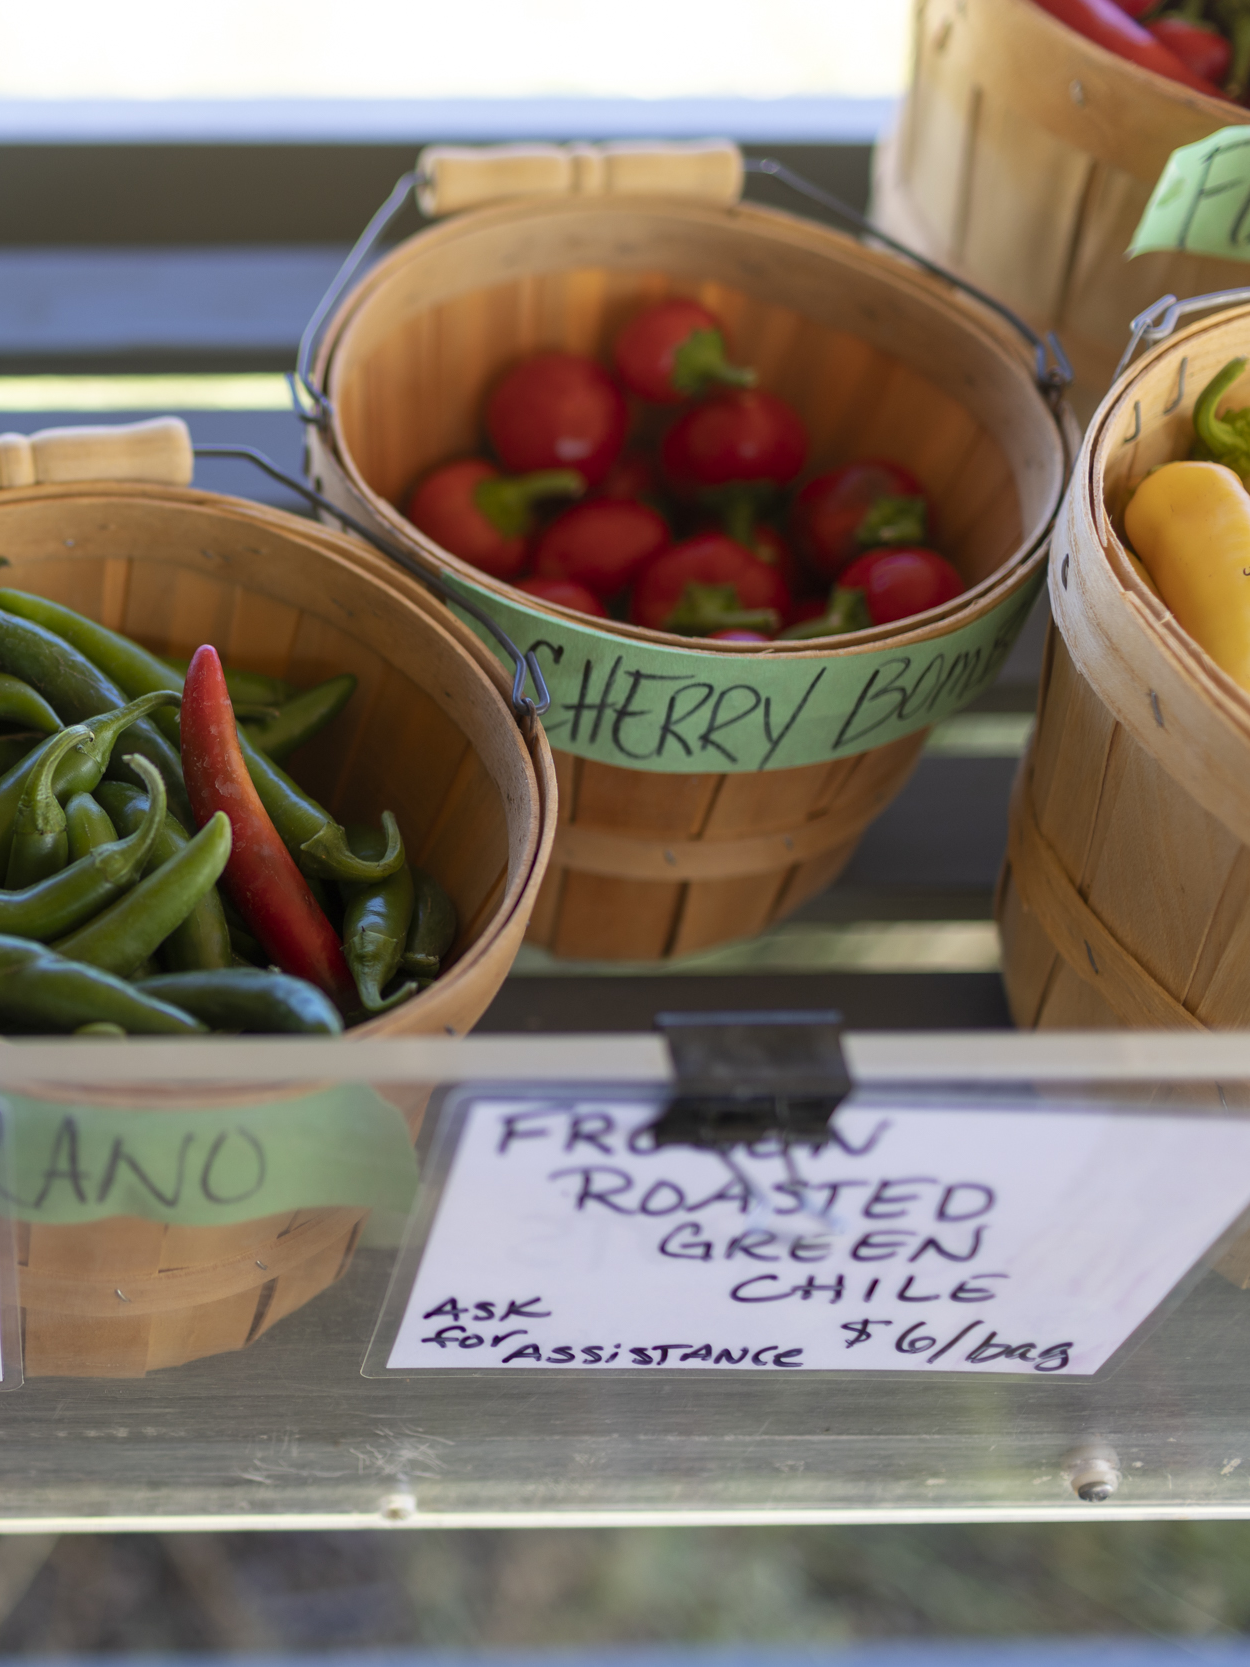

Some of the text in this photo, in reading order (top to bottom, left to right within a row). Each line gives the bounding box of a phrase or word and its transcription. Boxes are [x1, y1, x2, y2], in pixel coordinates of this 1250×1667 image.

[547, 1165, 996, 1222] ROASTED
[658, 1222, 990, 1262] GREEN
[730, 1274, 1011, 1304] CHILE
[423, 1297, 552, 1322] ASK
[422, 1326, 528, 1348] for
